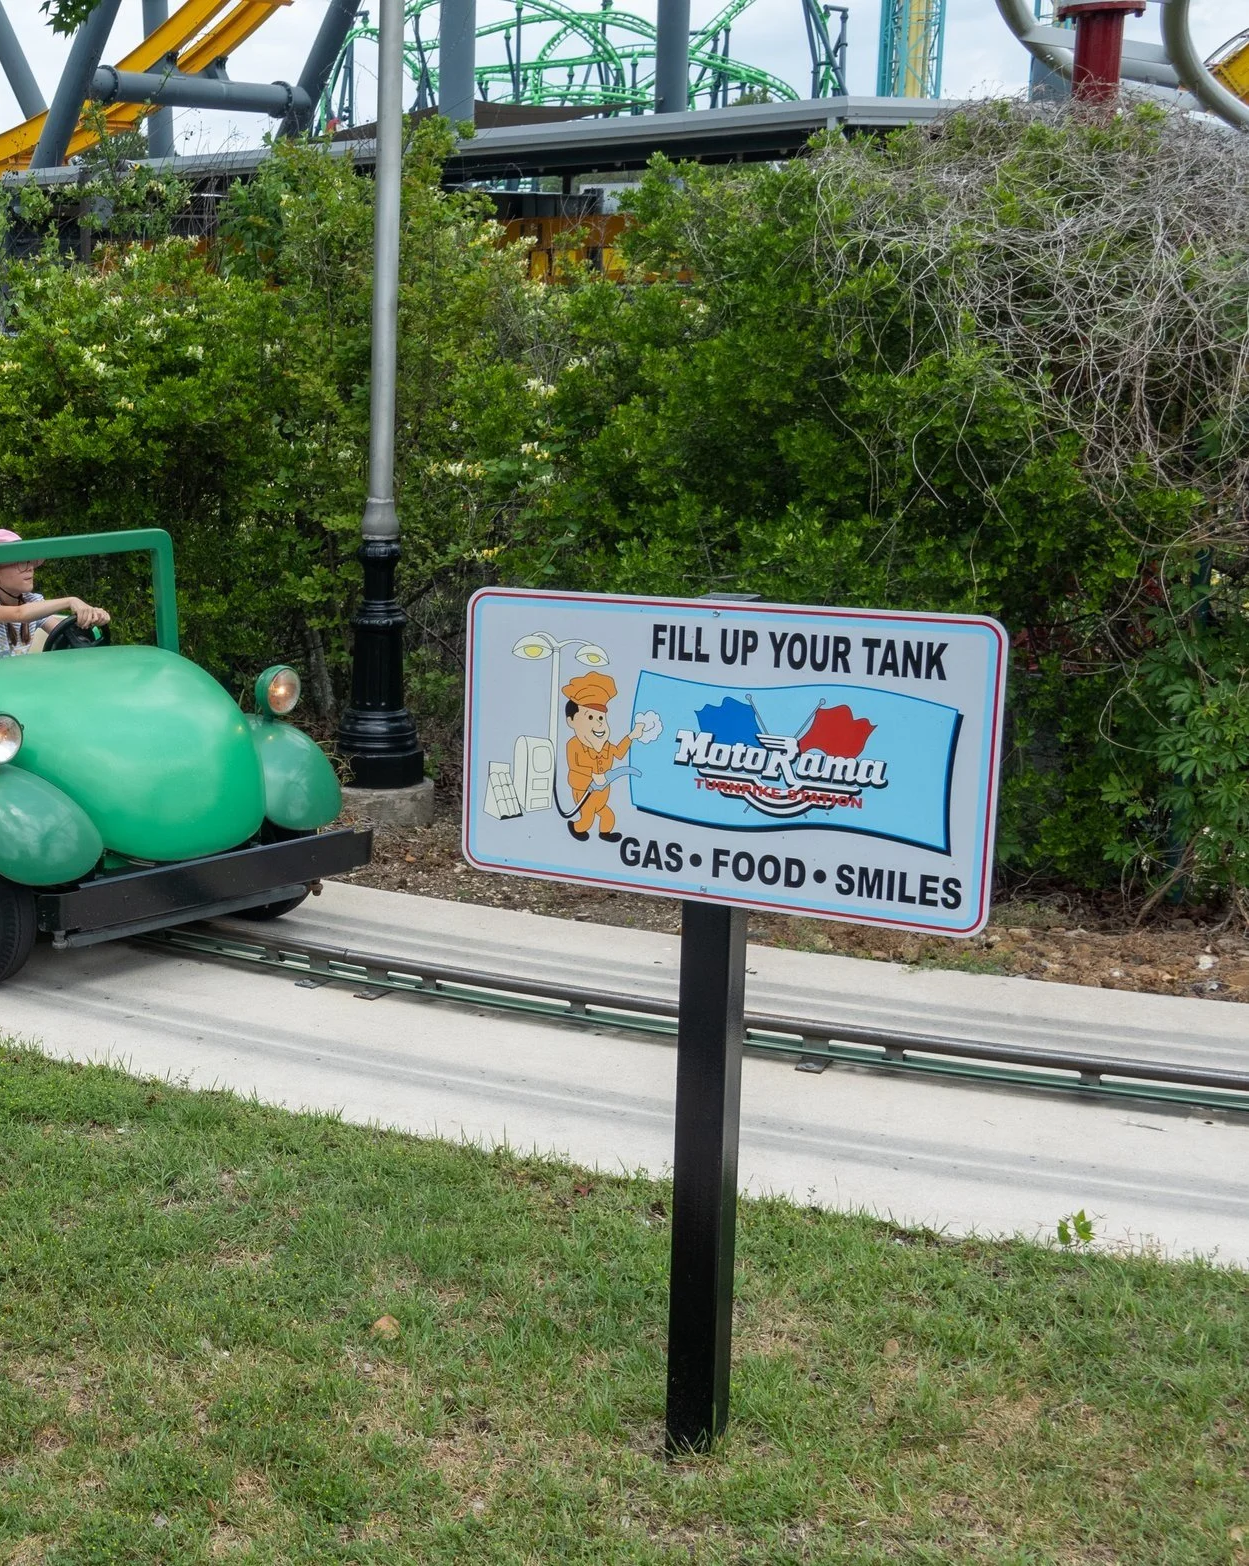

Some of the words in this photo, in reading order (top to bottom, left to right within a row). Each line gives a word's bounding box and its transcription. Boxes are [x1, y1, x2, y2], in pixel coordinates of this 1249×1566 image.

[651, 623, 710, 663] FILL
[719, 628, 758, 667] UP
[768, 631, 851, 674] YOUR
[862, 637, 949, 681] TANK
[674, 729, 889, 789] MotoRama
[694, 778, 782, 800] TURNPIKE
[787, 789, 863, 809] STATION
[620, 837, 684, 873] GAS
[712, 849, 806, 889] FOOD
[835, 865, 963, 910] SMILES
